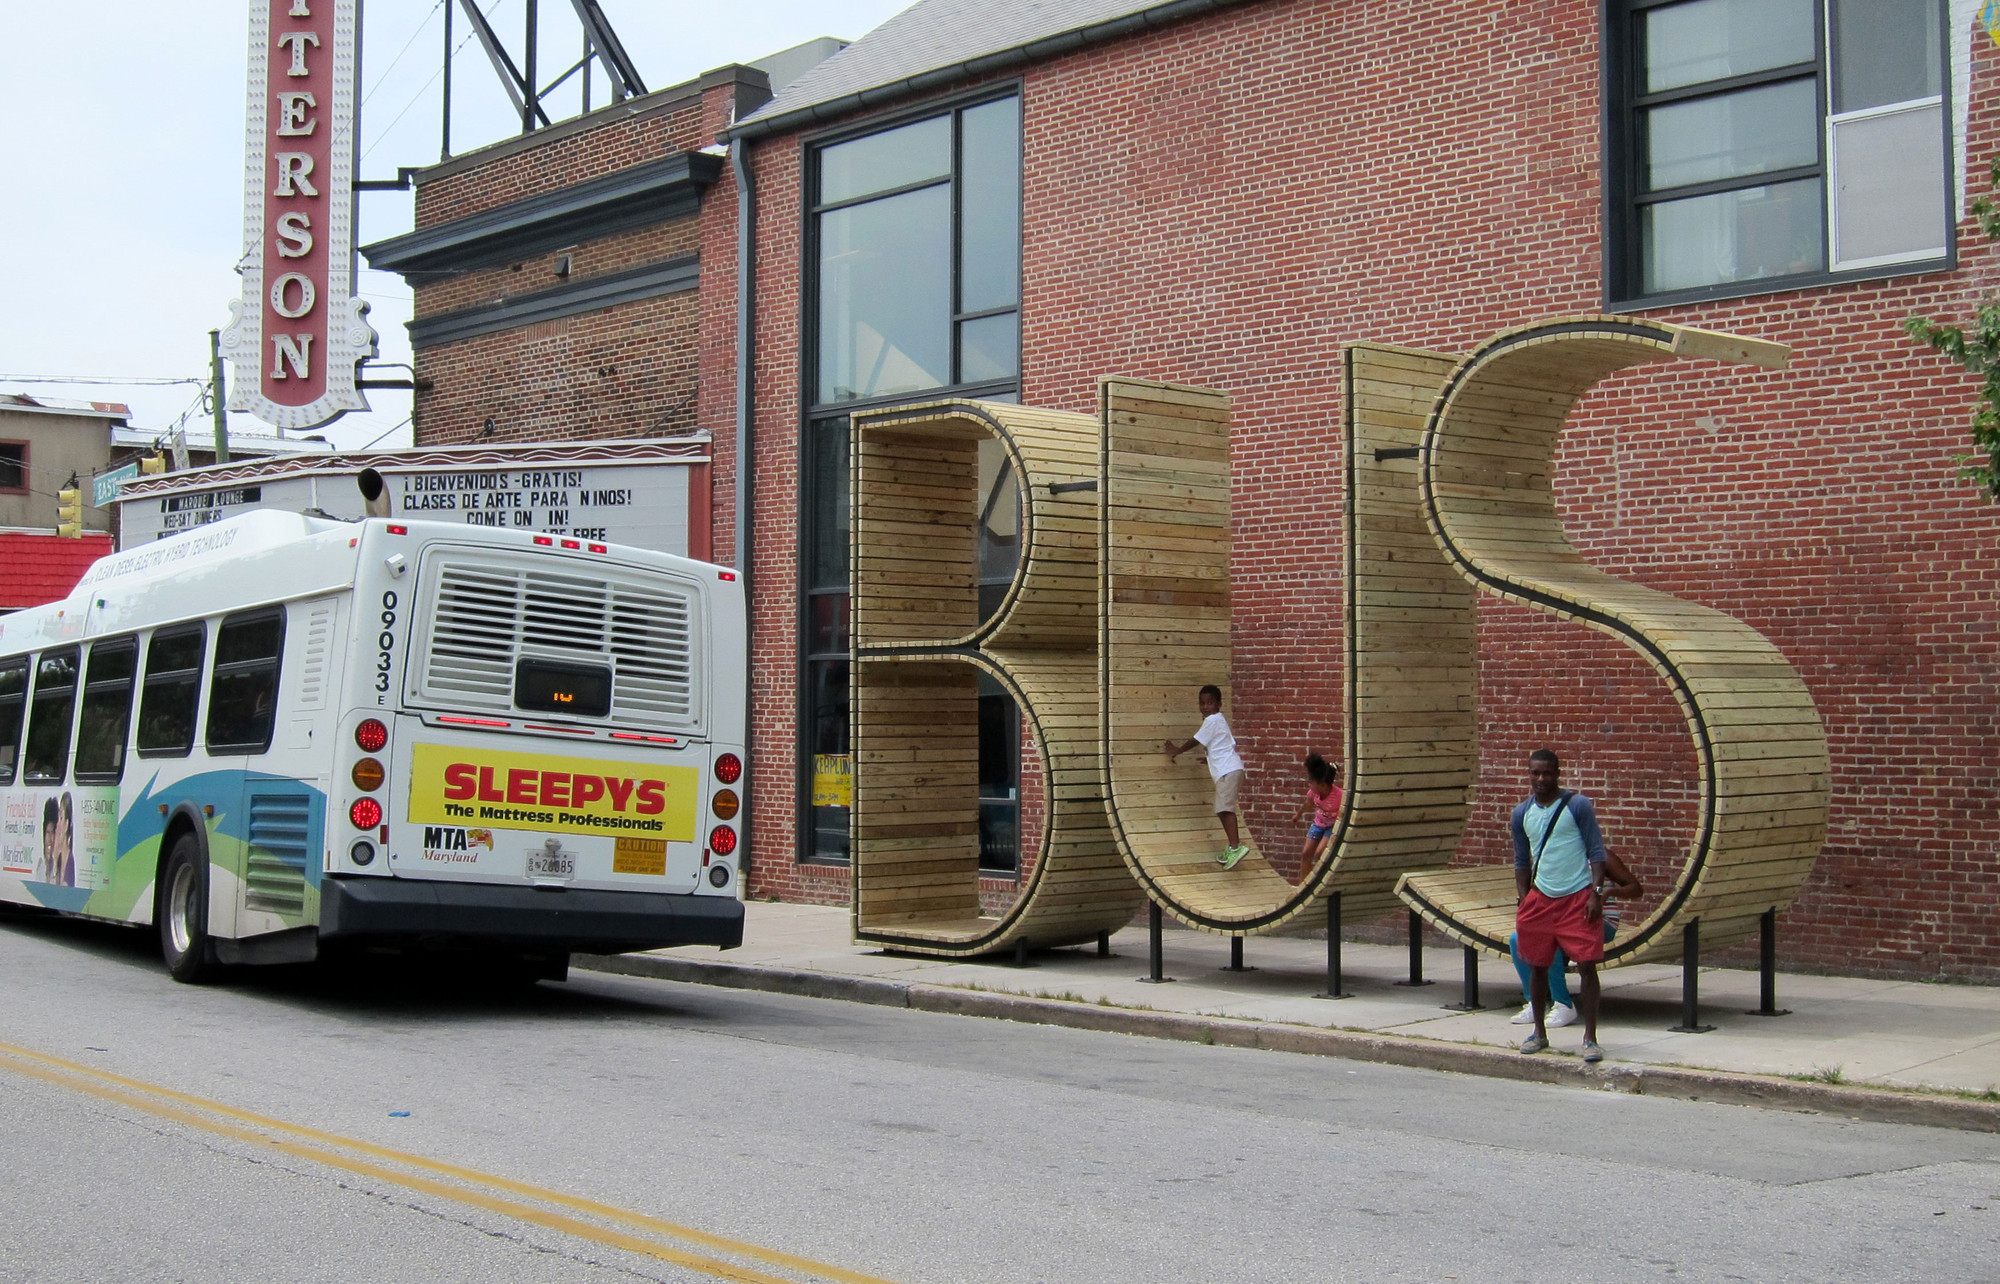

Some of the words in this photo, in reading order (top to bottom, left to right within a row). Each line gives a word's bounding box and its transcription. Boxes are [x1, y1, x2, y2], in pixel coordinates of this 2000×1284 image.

[98, 477, 117, 500] EAST
[215, 490, 244, 506] LOUNGE
[404, 494, 455, 510] CLASES
[462, 493, 479, 508] DE
[486, 492, 521, 508] ARTE
[530, 491, 568, 507] PARA
[194, 510, 222, 525] DINNERS
[467, 511, 506, 526] COME
[514, 510, 532, 526] ON
[549, 510, 568, 525] IN!
[189, 527, 239, 557] TECHNOLOGY
[573, 528, 606, 542] FREE
[375, 590, 398, 692] 09033
[377, 696, 385, 705] E
[444, 804, 475, 818] The
[480, 806, 554, 824] Mattress
[559, 812, 663, 831] Professionals
[423, 826, 468, 851] MTA
[618, 838, 665, 852] CAUTION
[421, 849, 479, 864] Maryland
